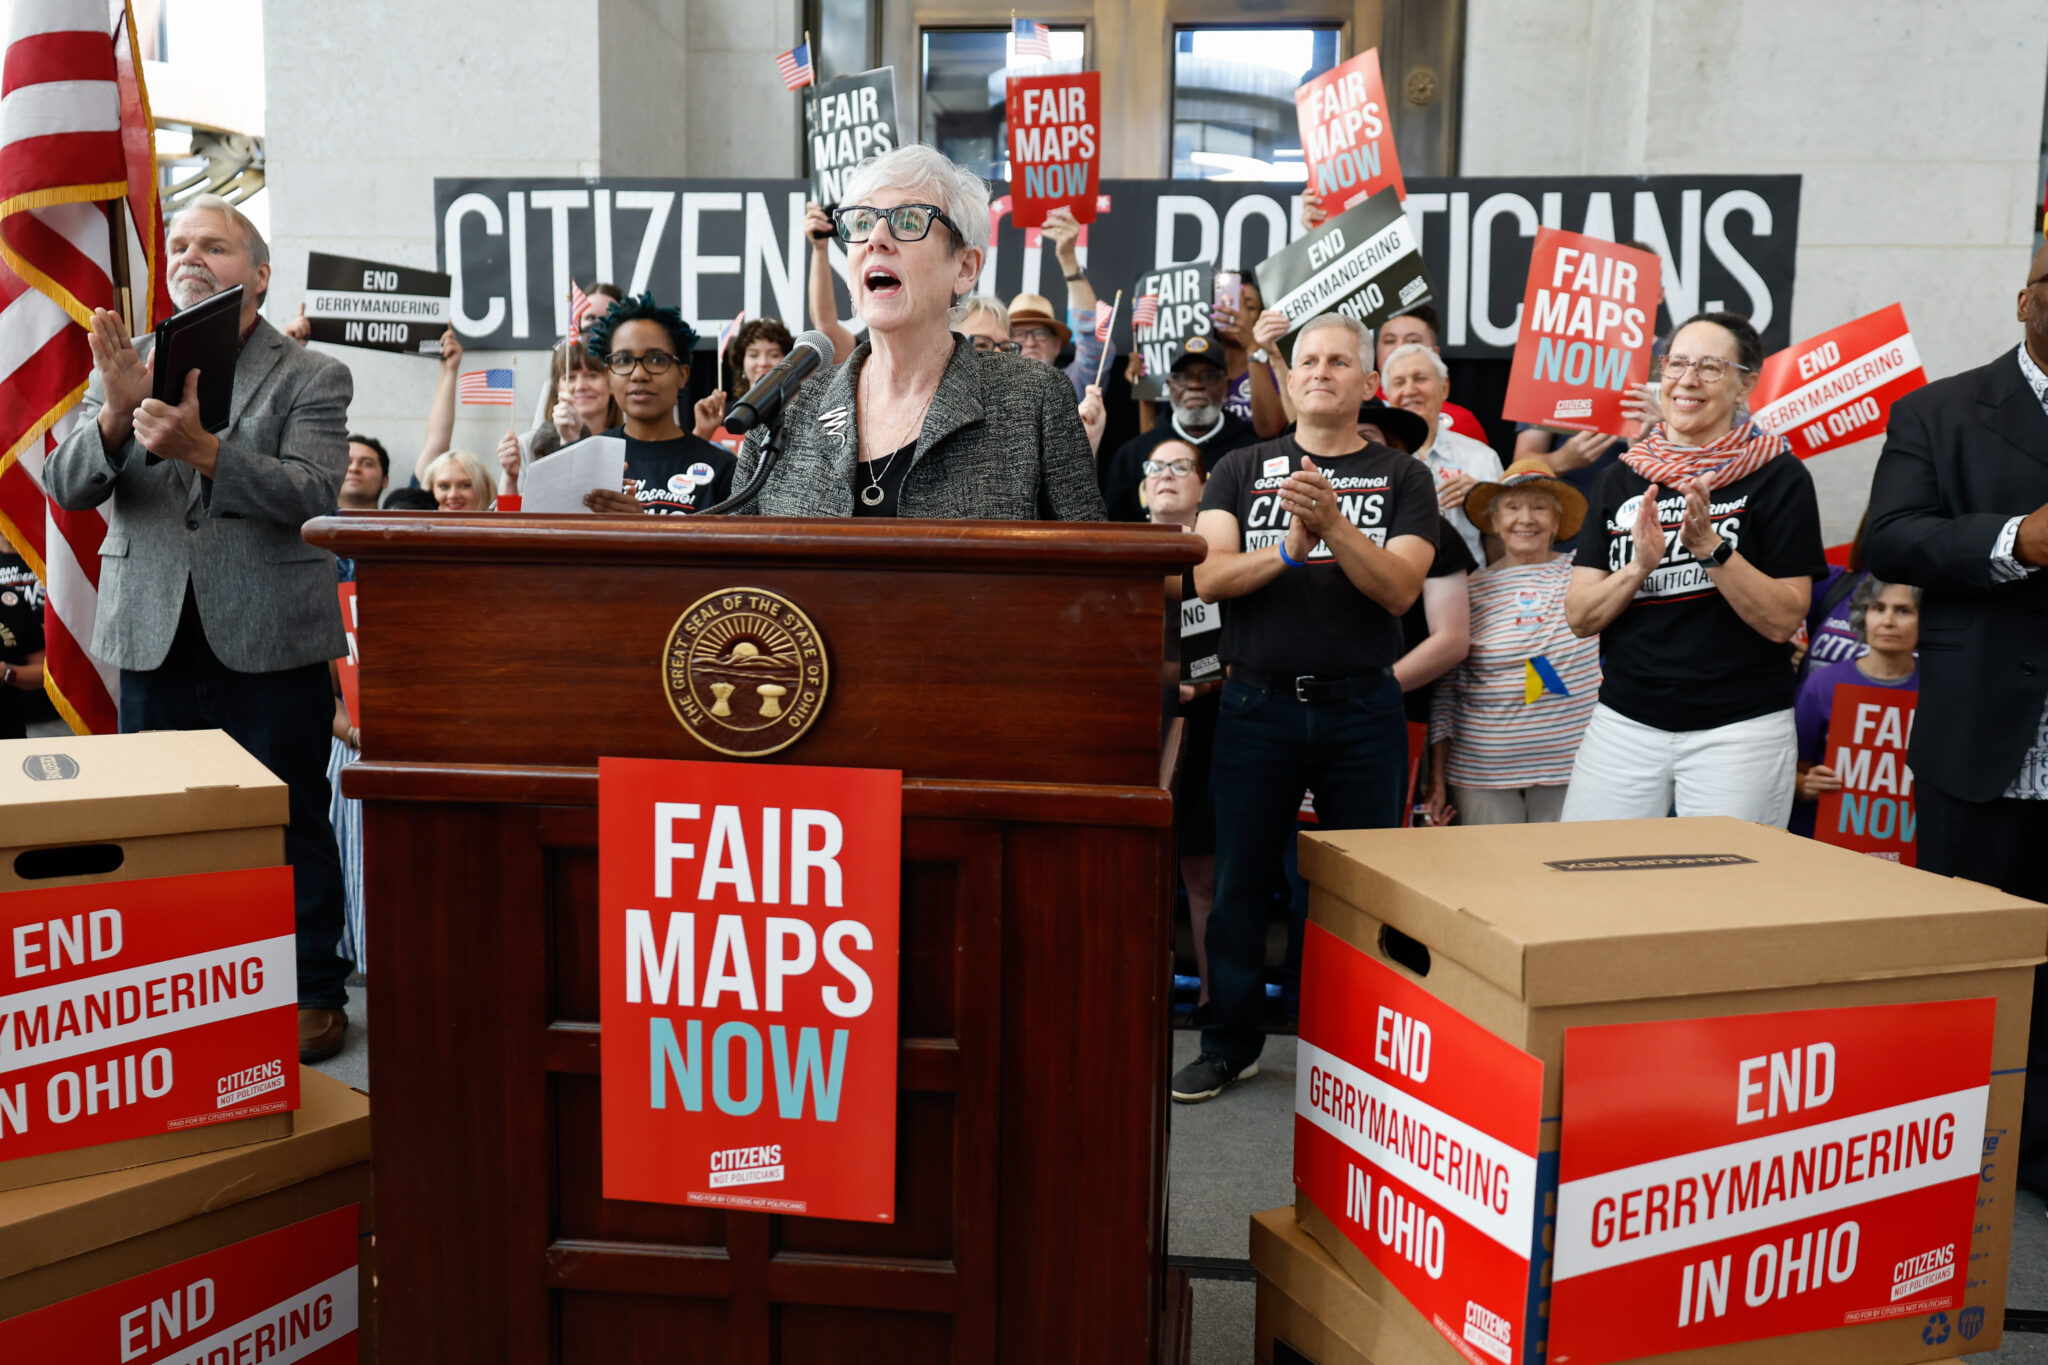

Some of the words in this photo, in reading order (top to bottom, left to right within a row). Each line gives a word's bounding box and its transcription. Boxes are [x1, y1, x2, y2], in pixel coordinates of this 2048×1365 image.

[821, 87, 879, 133] FAIR
[1023, 87, 1087, 125] FAIR
[1309, 71, 1367, 125] FAIR
[814, 121, 892, 170] MAPS
[1015, 124, 1096, 162] MAPS
[1306, 102, 1383, 164] MAPS
[1025, 162, 1089, 199] NOW
[1317, 141, 1381, 196] NOW
[444, 187, 868, 337] CITIZEN
[1307, 228, 1345, 270] END
[363, 270, 398, 291] END
[1146, 269, 1200, 306] FAIR
[1281, 231, 1400, 321] ERRYMANDERING
[1552, 246, 1638, 304] FAIR
[316, 297, 440, 316] GERRYMANDERING
[1531, 289, 1646, 349] MAPS
[345, 322, 363, 341] IN
[367, 322, 408, 343] OHIO
[1533, 337, 1632, 391] NOW
[1798, 341, 1841, 381] END
[1760, 348, 1904, 432] GERRYMANDERING
[1802, 421, 1830, 449] IN
[1827, 396, 1880, 437] OHIO
[685, 604, 721, 635] SEAL
[722, 596, 743, 611] OF
[749, 597, 781, 616] THE
[784, 614, 817, 659] STATE
[671, 638, 689, 690] GREAT
[807, 665, 820, 686] OF
[679, 695, 705, 726] THE
[789, 692, 815, 727] OHIO
[654, 802, 843, 907] FAIR
[13, 908, 123, 979] END
[625, 908, 873, 1018] MAPS
[1374, 1005, 1432, 1084] END
[47, 1047, 173, 1124] OHIO
[217, 1059, 282, 1094] CITIZENS
[220, 1093, 235, 1105] NOT
[236, 1078, 281, 1100] POLITICIANS
[650, 1017, 849, 1122] NOW
[1736, 1041, 1836, 1126] END
[169, 1120, 185, 1128] PAID
[208, 1112, 234, 1120] CITIZENS
[249, 1102, 286, 1113] POLITICIANS
[710, 1144, 781, 1171] CITIZENS
[1310, 1065, 1510, 1215] GERRYMANDERING
[713, 1173, 729, 1185] NOT
[731, 1167, 780, 1184] POLITICIANS
[1590, 1112, 1956, 1249] GERRYMANDERING
[1346, 1162, 1372, 1231] IN
[1378, 1185, 1445, 1280] OHIO
[1678, 1254, 1731, 1328] IN
[1744, 1220, 1860, 1308] OHIO
[1894, 1243, 1954, 1283] CITIZENS
[1894, 1284, 1908, 1298] NOT
[1909, 1267, 1952, 1293] POLITICIANS
[120, 1278, 215, 1364] END
[1466, 1300, 1512, 1344] CITIZENS
[1846, 1312, 1860, 1321] PAID
[1861, 1310, 1873, 1319] FOR
[1881, 1305, 1905, 1316] CITIZENS
[1906, 1303, 1918, 1312] NOT
[1918, 1298, 1951, 1310] POLITICIANS
[1963, 1312, 1982, 1325] USA
